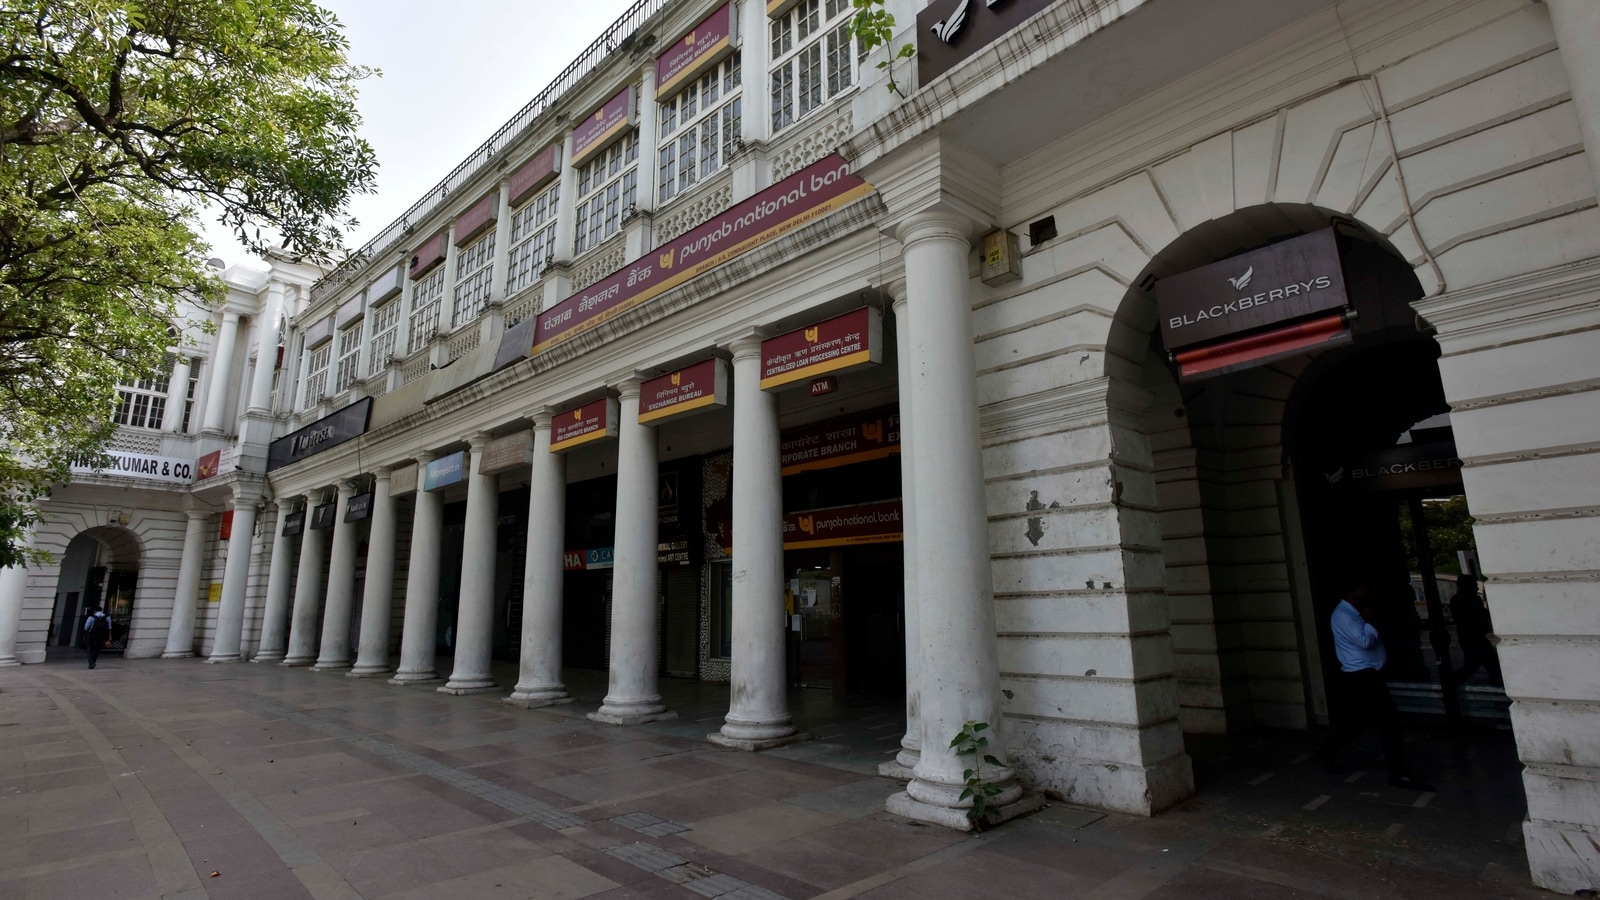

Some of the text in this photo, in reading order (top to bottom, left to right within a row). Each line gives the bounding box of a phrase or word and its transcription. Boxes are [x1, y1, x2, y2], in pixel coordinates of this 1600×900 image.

[662, 34, 720, 82] EXCHANGE BUREAU
[679, 223, 733, 264] punjab
[734, 183, 807, 232] national
[727, 238, 759, 257] CONNAUGHT
[778, 223, 792, 234] NEW
[543, 309, 572, 331] पंजाब
[626, 265, 653, 288] बैंक
[1169, 275, 1332, 330] BLACKBERRYS
[766, 342, 862, 376] CENTRALIZED LOAN PROCESSING CENTRE
[811, 381, 829, 393] ATM
[648, 389, 703, 411] EXCHANGE BUREAU
[826, 427, 857, 441] शाखा
[820, 439, 857, 456] BRANCH
[113, 455, 158, 475] KUMAR
[161, 461, 170, 476] &
[174, 463, 192, 479] CO.
[816, 509, 900, 532] punjab national bank
[564, 553, 582, 568] HA
